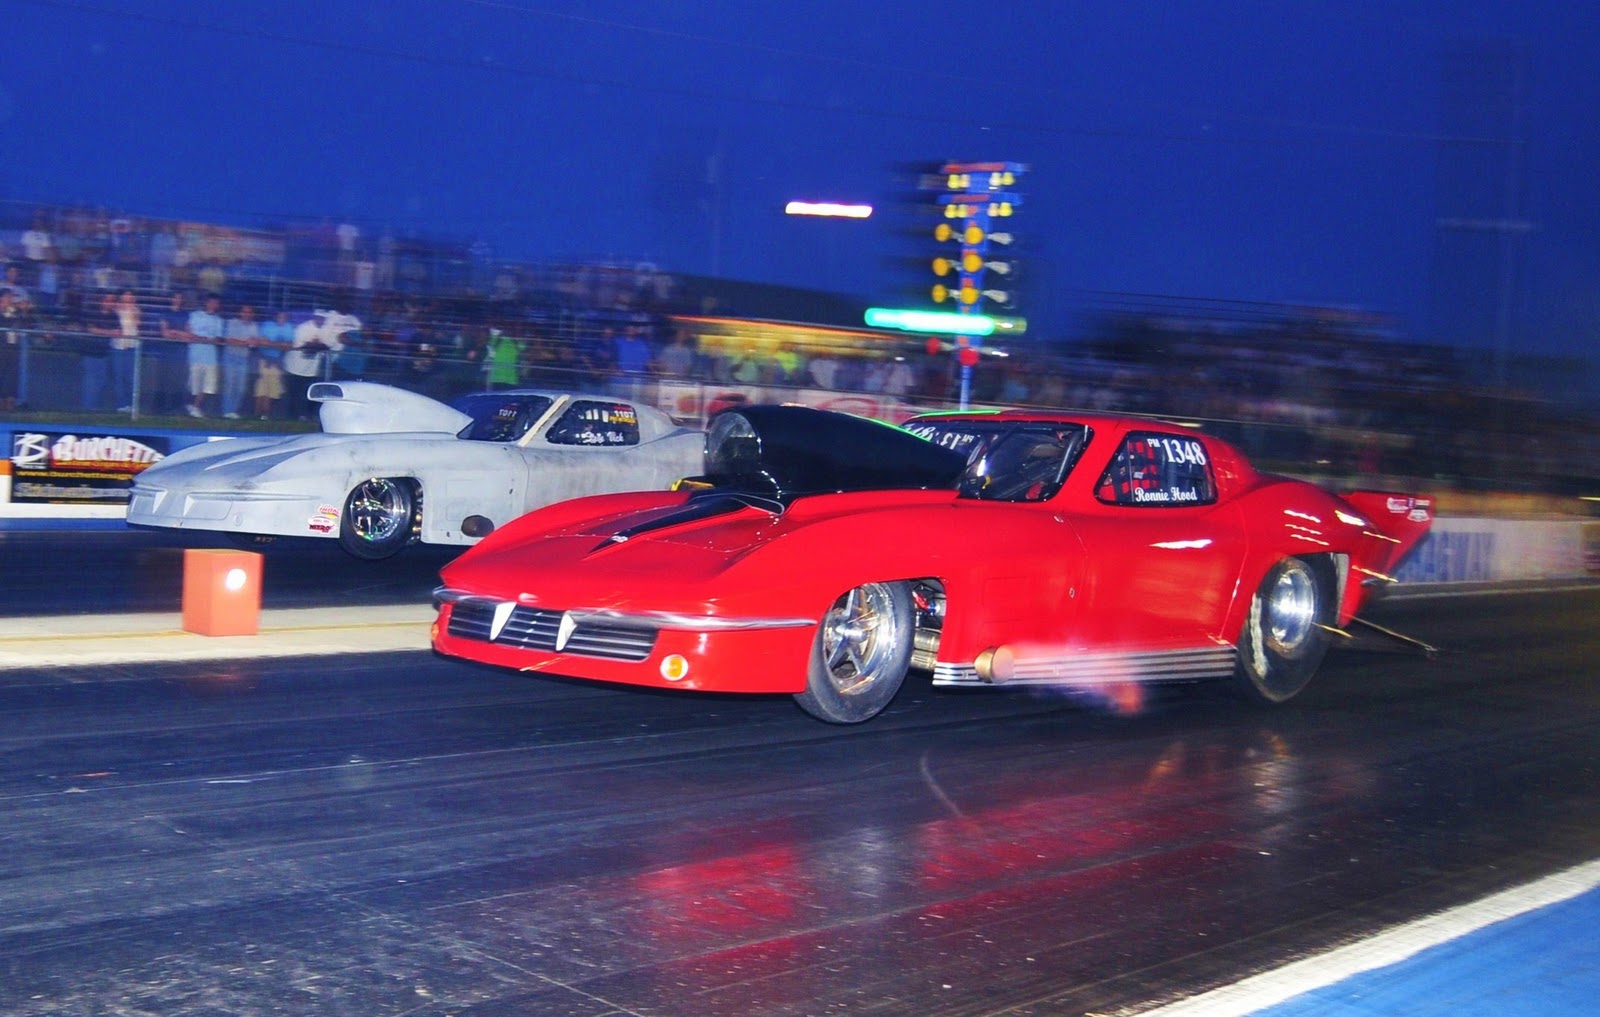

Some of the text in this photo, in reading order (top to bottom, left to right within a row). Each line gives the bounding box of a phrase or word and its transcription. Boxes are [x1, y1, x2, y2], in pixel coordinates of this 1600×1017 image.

[614, 410, 634, 418] 1107
[1147, 438, 1206, 466] PM 1348
[1135, 487, 1197, 502] Ronnie Hood
